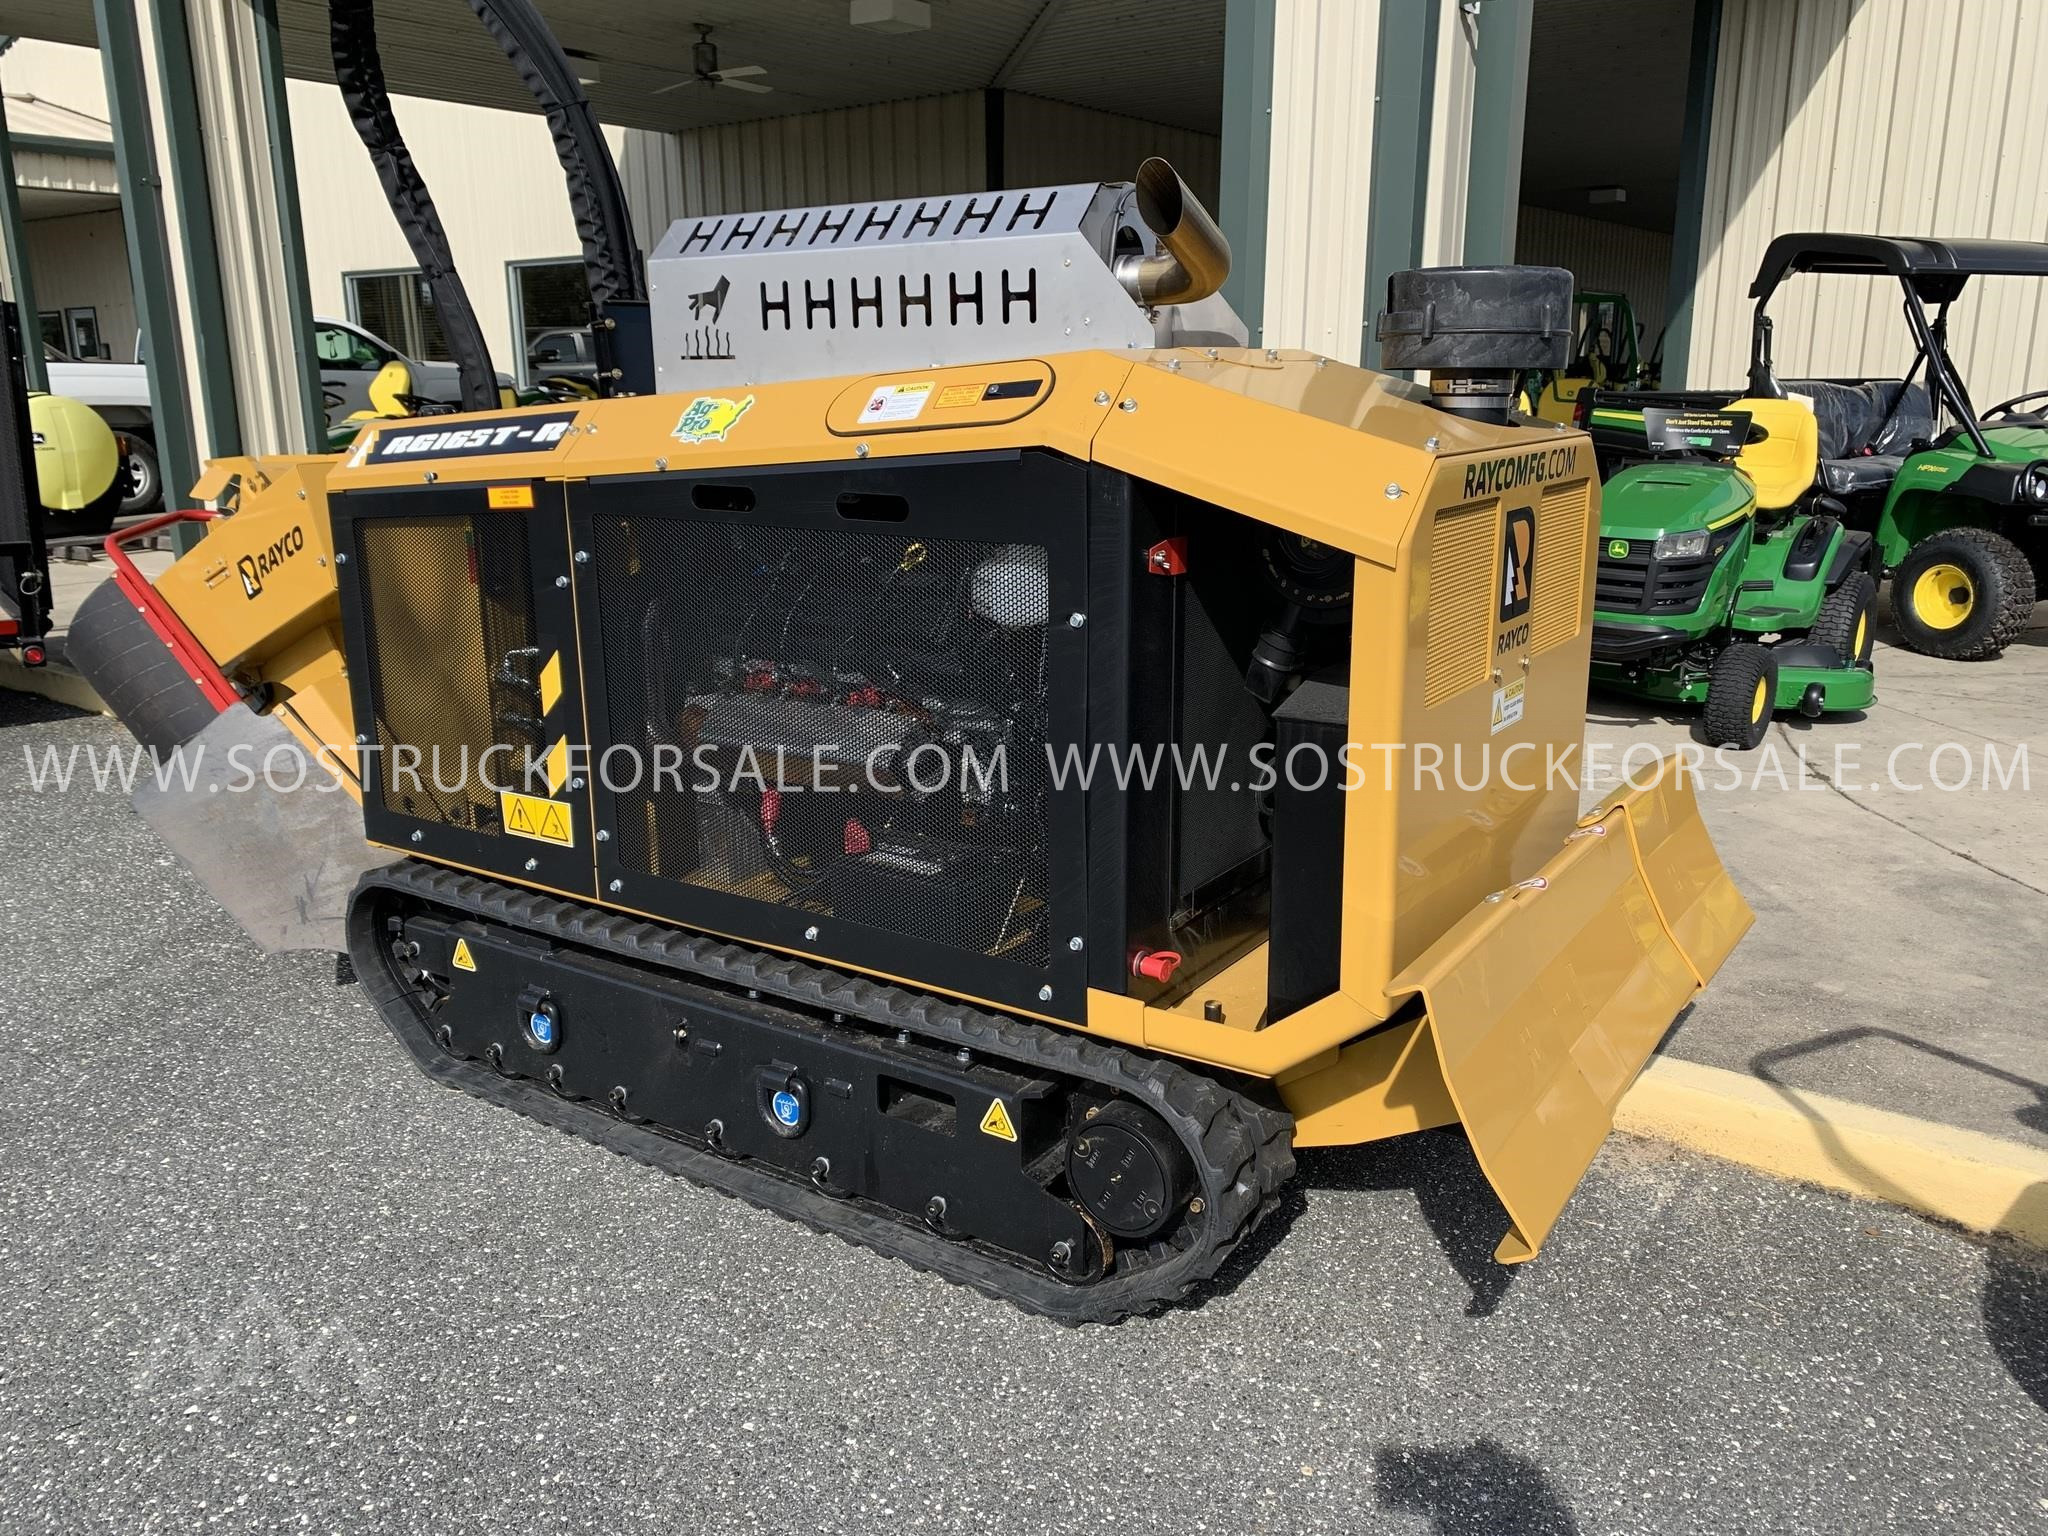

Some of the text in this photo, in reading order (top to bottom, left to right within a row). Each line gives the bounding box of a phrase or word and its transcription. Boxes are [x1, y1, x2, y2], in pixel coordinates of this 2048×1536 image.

[1464, 446, 1577, 499] RAYCOMFG.COM
[257, 525, 304, 579] RAYCO
[1496, 622, 1529, 657] RAYCO
